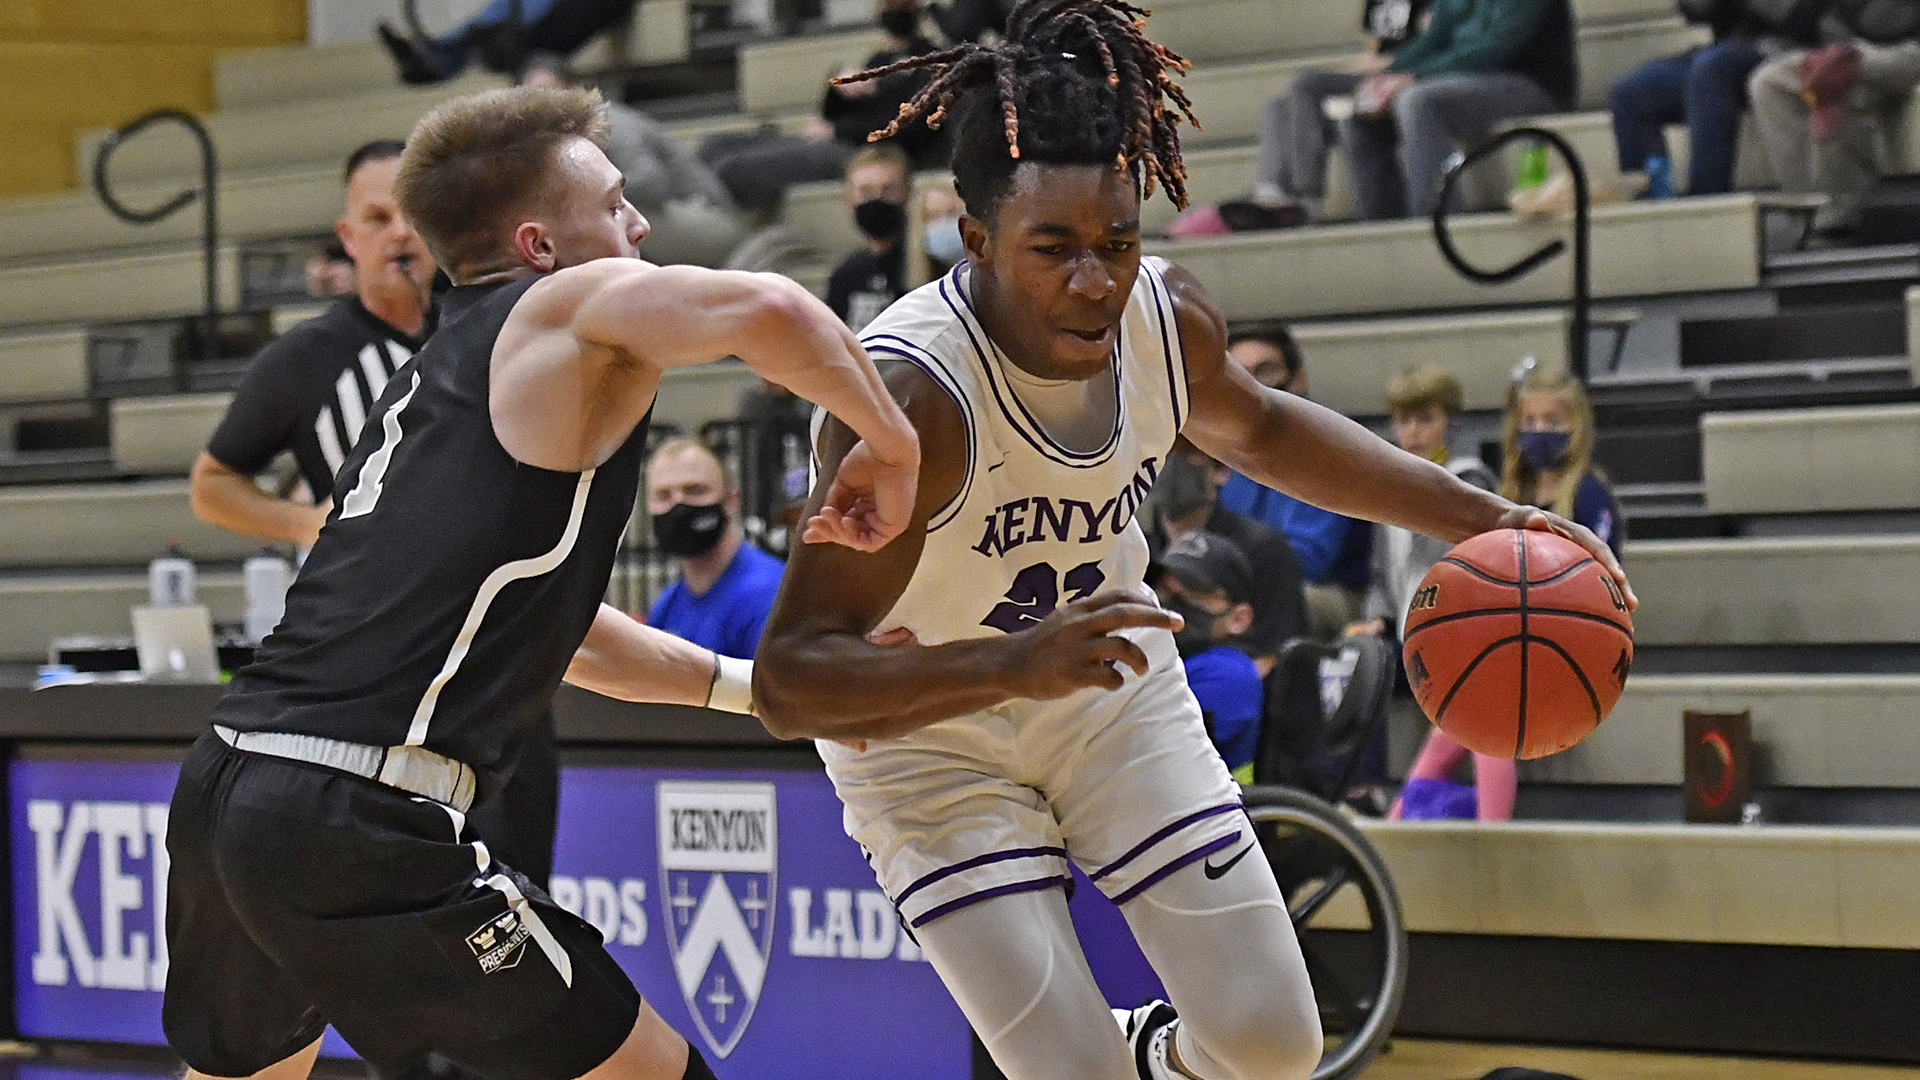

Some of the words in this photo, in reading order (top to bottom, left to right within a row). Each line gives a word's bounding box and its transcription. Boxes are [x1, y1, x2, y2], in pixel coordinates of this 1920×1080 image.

[338, 369, 421, 521] 1
[971, 457, 1158, 559] KENYON
[669, 808, 767, 852] KENYON
[788, 887, 930, 962] LAD
